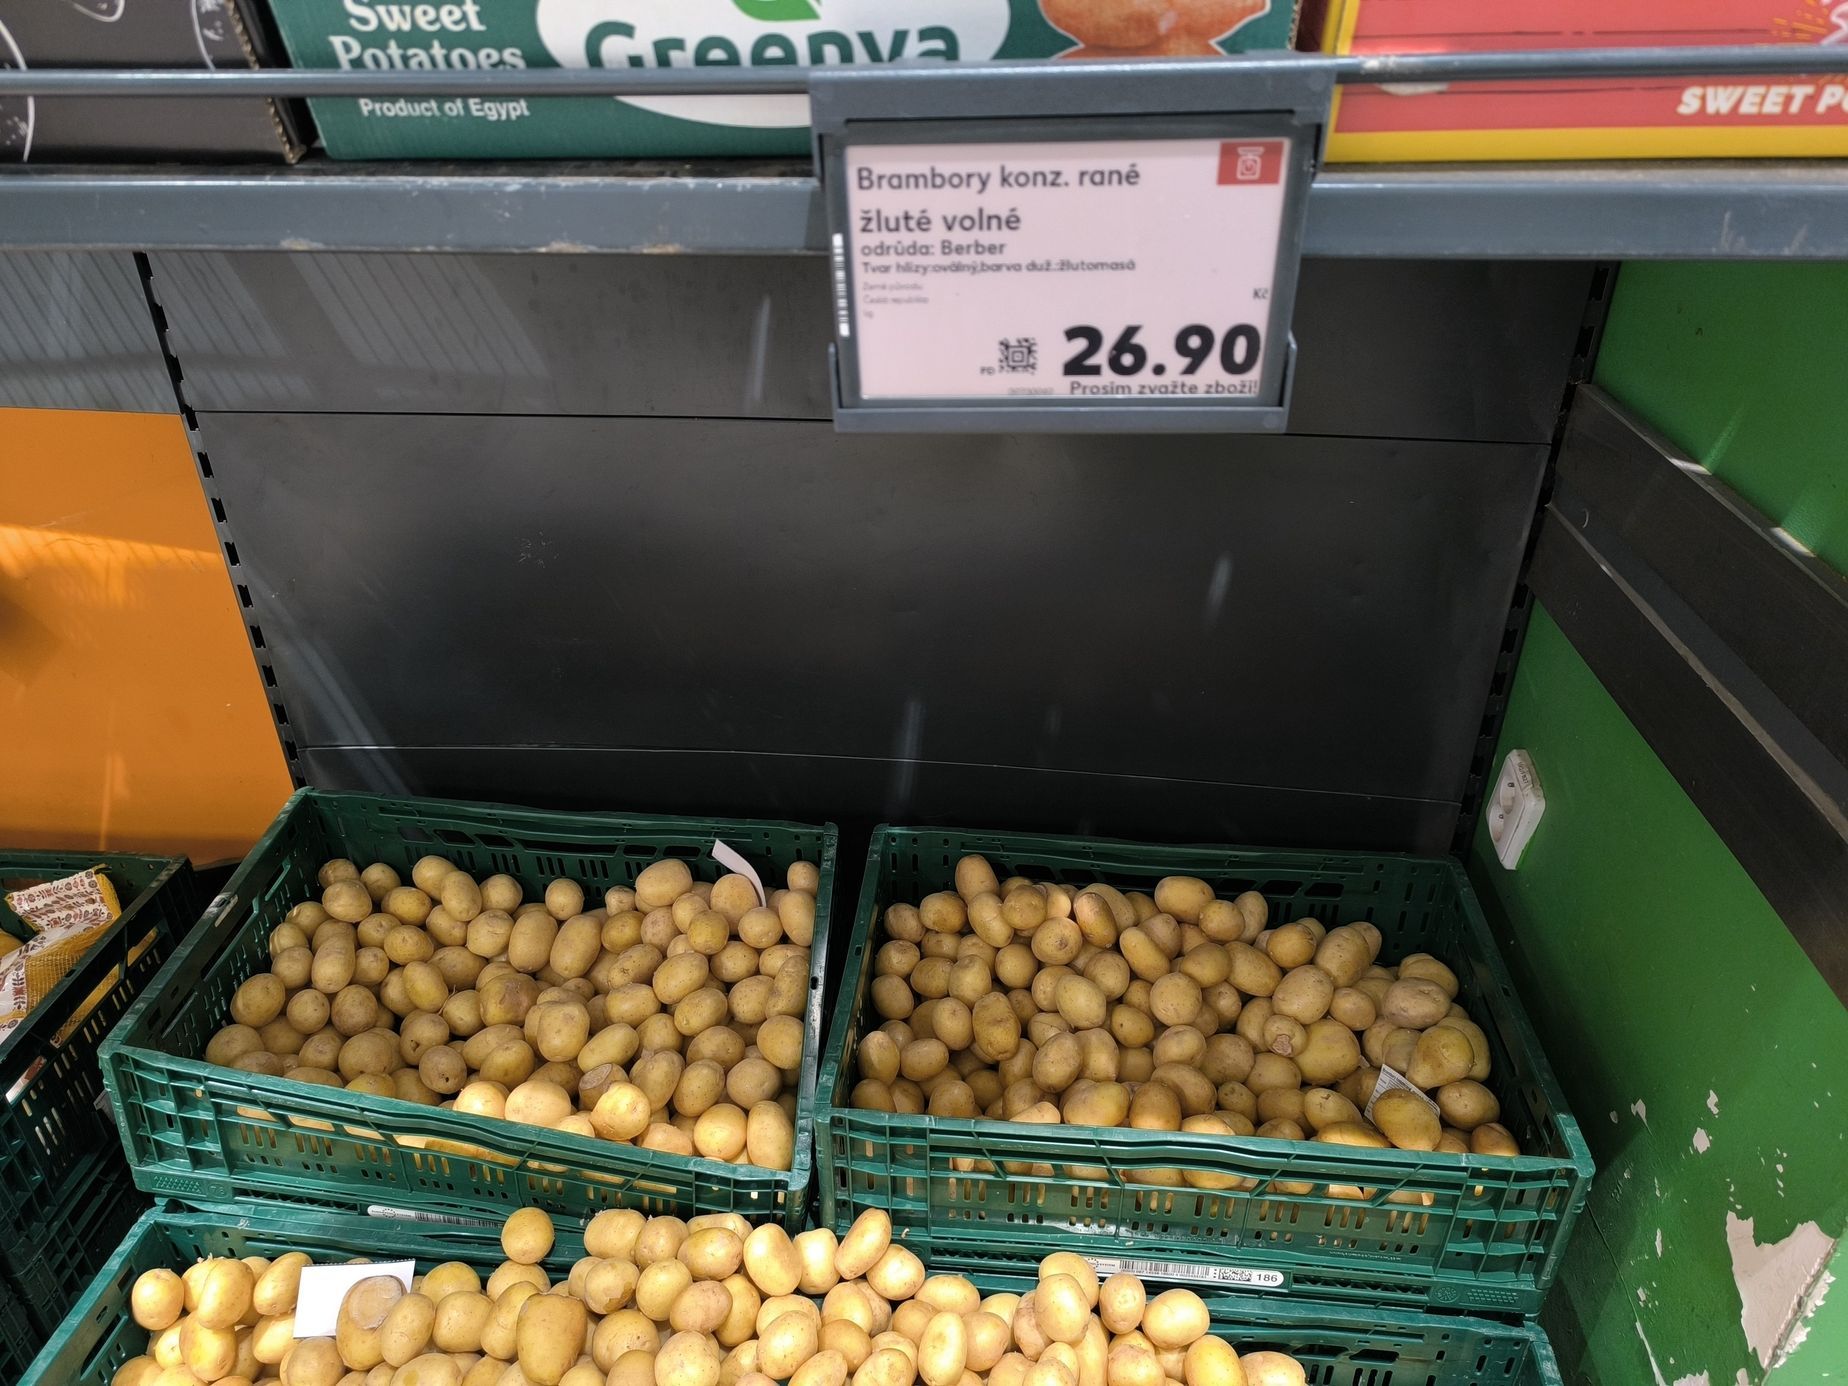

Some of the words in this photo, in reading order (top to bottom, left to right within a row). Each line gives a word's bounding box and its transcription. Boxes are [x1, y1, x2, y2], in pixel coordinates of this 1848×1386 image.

[344, 0, 487, 31] Sweet
[328, 35, 528, 70] Potatoes
[358, 98, 441, 117] Product
[444, 98, 464, 116] of
[468, 98, 530, 120] Egypt
[1676, 84, 1815, 115] SWEET
[1816, 84, 1848, 114] P
[857, 166, 991, 194] Brambory
[1000, 165, 1069, 187] konz.
[1078, 163, 1140, 186] rané
[860, 209, 932, 232] žluté
[942, 207, 1021, 231] volné
[861, 241, 935, 257] odrůda:
[941, 240, 1006, 255] Berber
[863, 262, 891, 274] Tvar
[1063, 324, 1261, 377] 26.90
[1138, 379, 1198, 395] zvažte
[1256, 1273, 1278, 1283] 186
